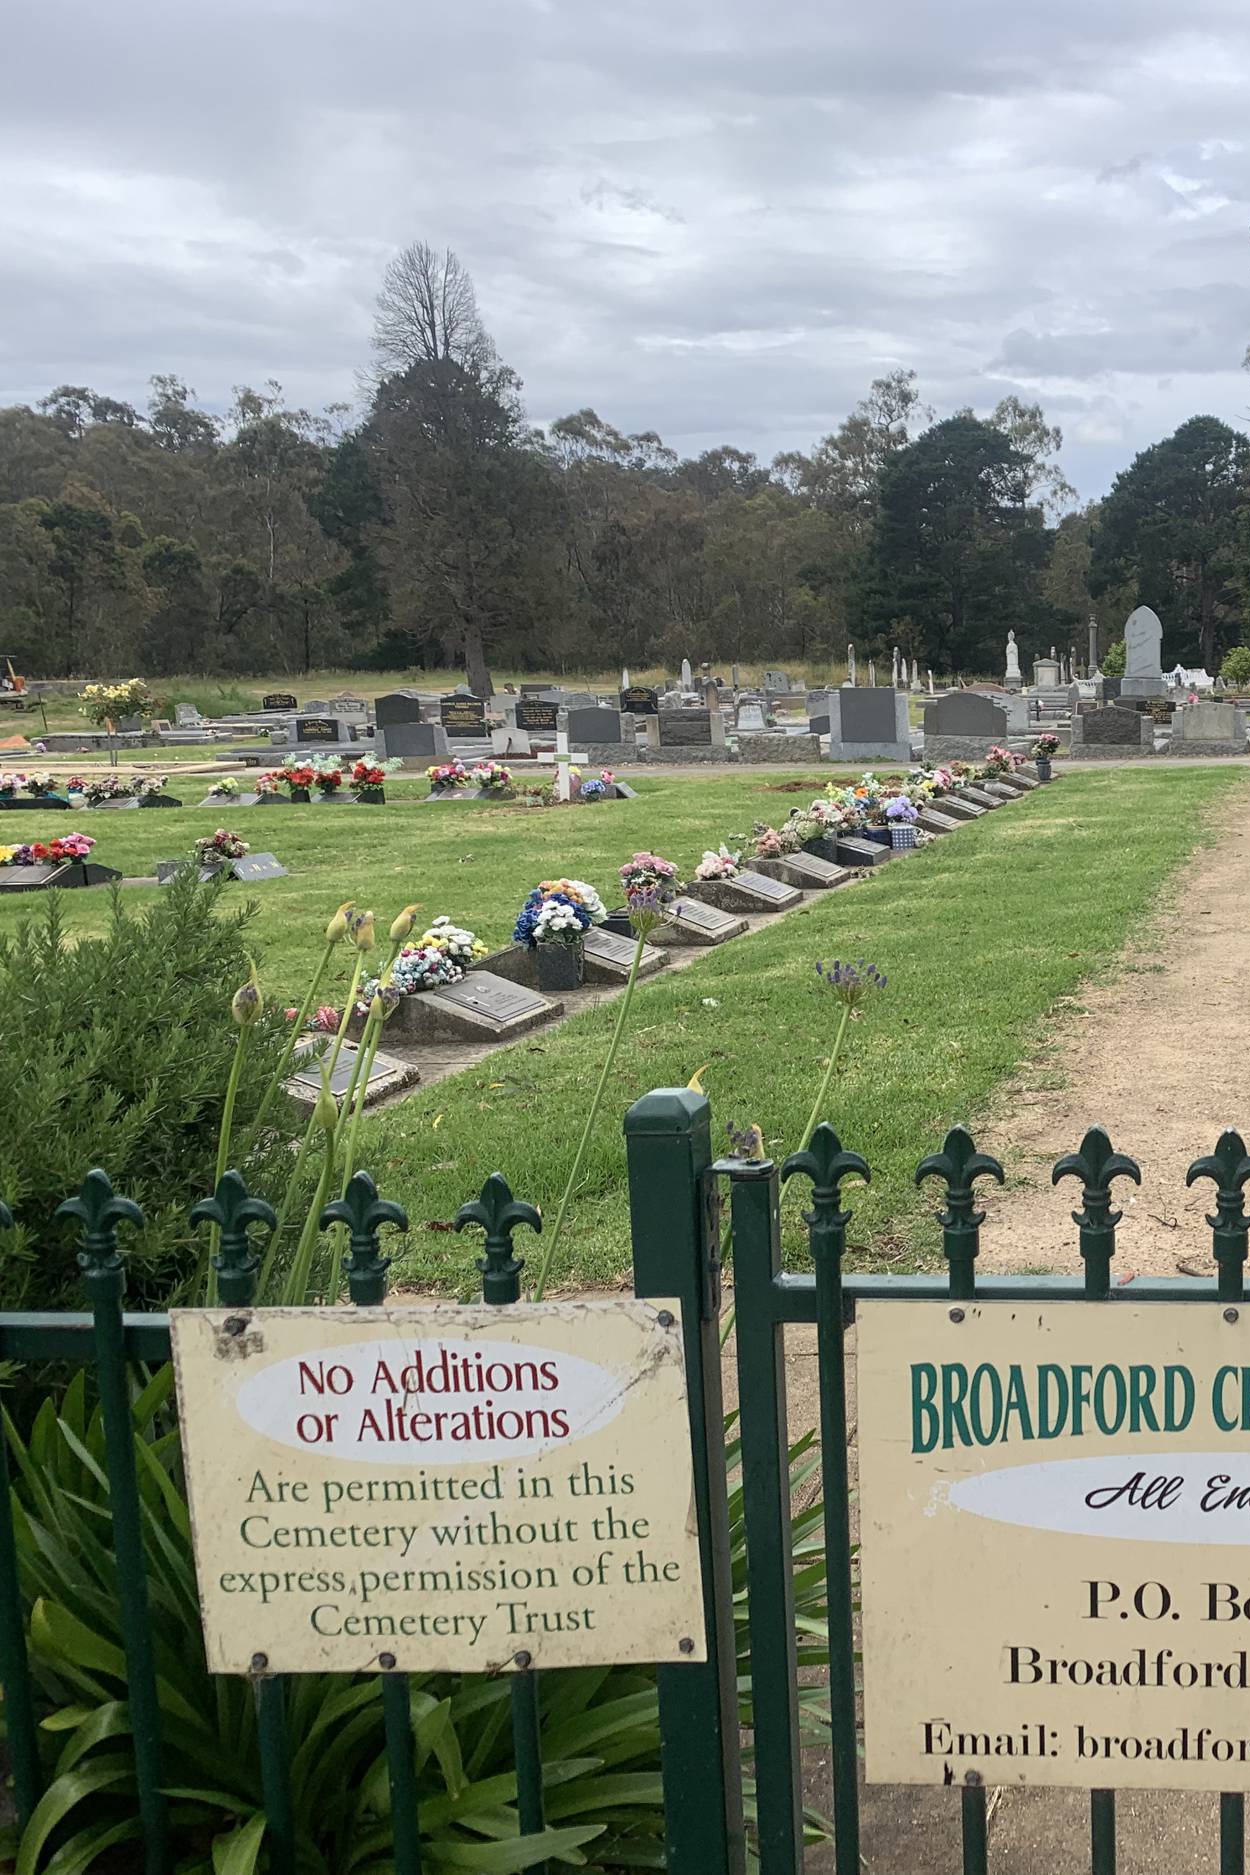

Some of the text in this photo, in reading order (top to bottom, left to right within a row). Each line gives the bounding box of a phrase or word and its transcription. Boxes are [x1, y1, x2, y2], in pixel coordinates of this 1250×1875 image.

[298, 1350, 559, 1396] No Additions
[296, 1398, 570, 1444] or Alterations
[909, 1362, 1196, 1454] BROADFORD
[245, 1462, 635, 1514] Are permitted in this
[1085, 1471, 1183, 1511] All
[239, 1506, 650, 1557] Cemetery without the
[219, 1549, 681, 1604] express permission of the
[1082, 1580, 1181, 1621] P.O.
[310, 1601, 596, 1647] Cemetery Trust
[1003, 1646, 1250, 1689] Broadford
[919, 1722, 1060, 1757] Email:
